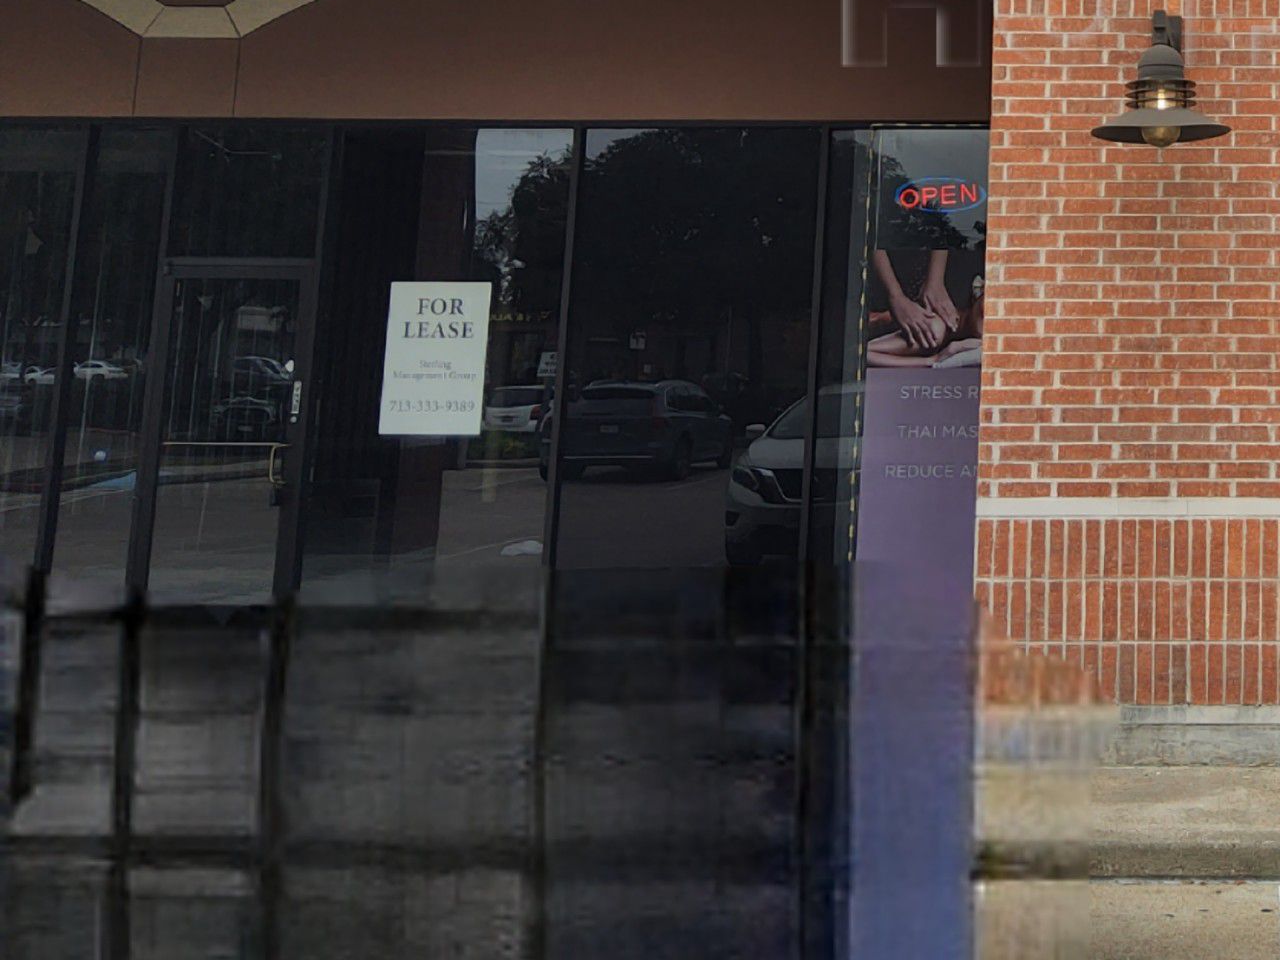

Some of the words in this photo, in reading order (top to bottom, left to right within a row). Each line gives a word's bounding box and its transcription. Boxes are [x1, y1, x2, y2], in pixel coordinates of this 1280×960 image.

[899, 184, 978, 208] OPEN
[418, 298, 464, 315] FOR
[403, 322, 474, 339] LEASE
[900, 385, 962, 399] STRESS
[896, 425, 937, 439] THAI
[884, 464, 954, 479] REDUCE
